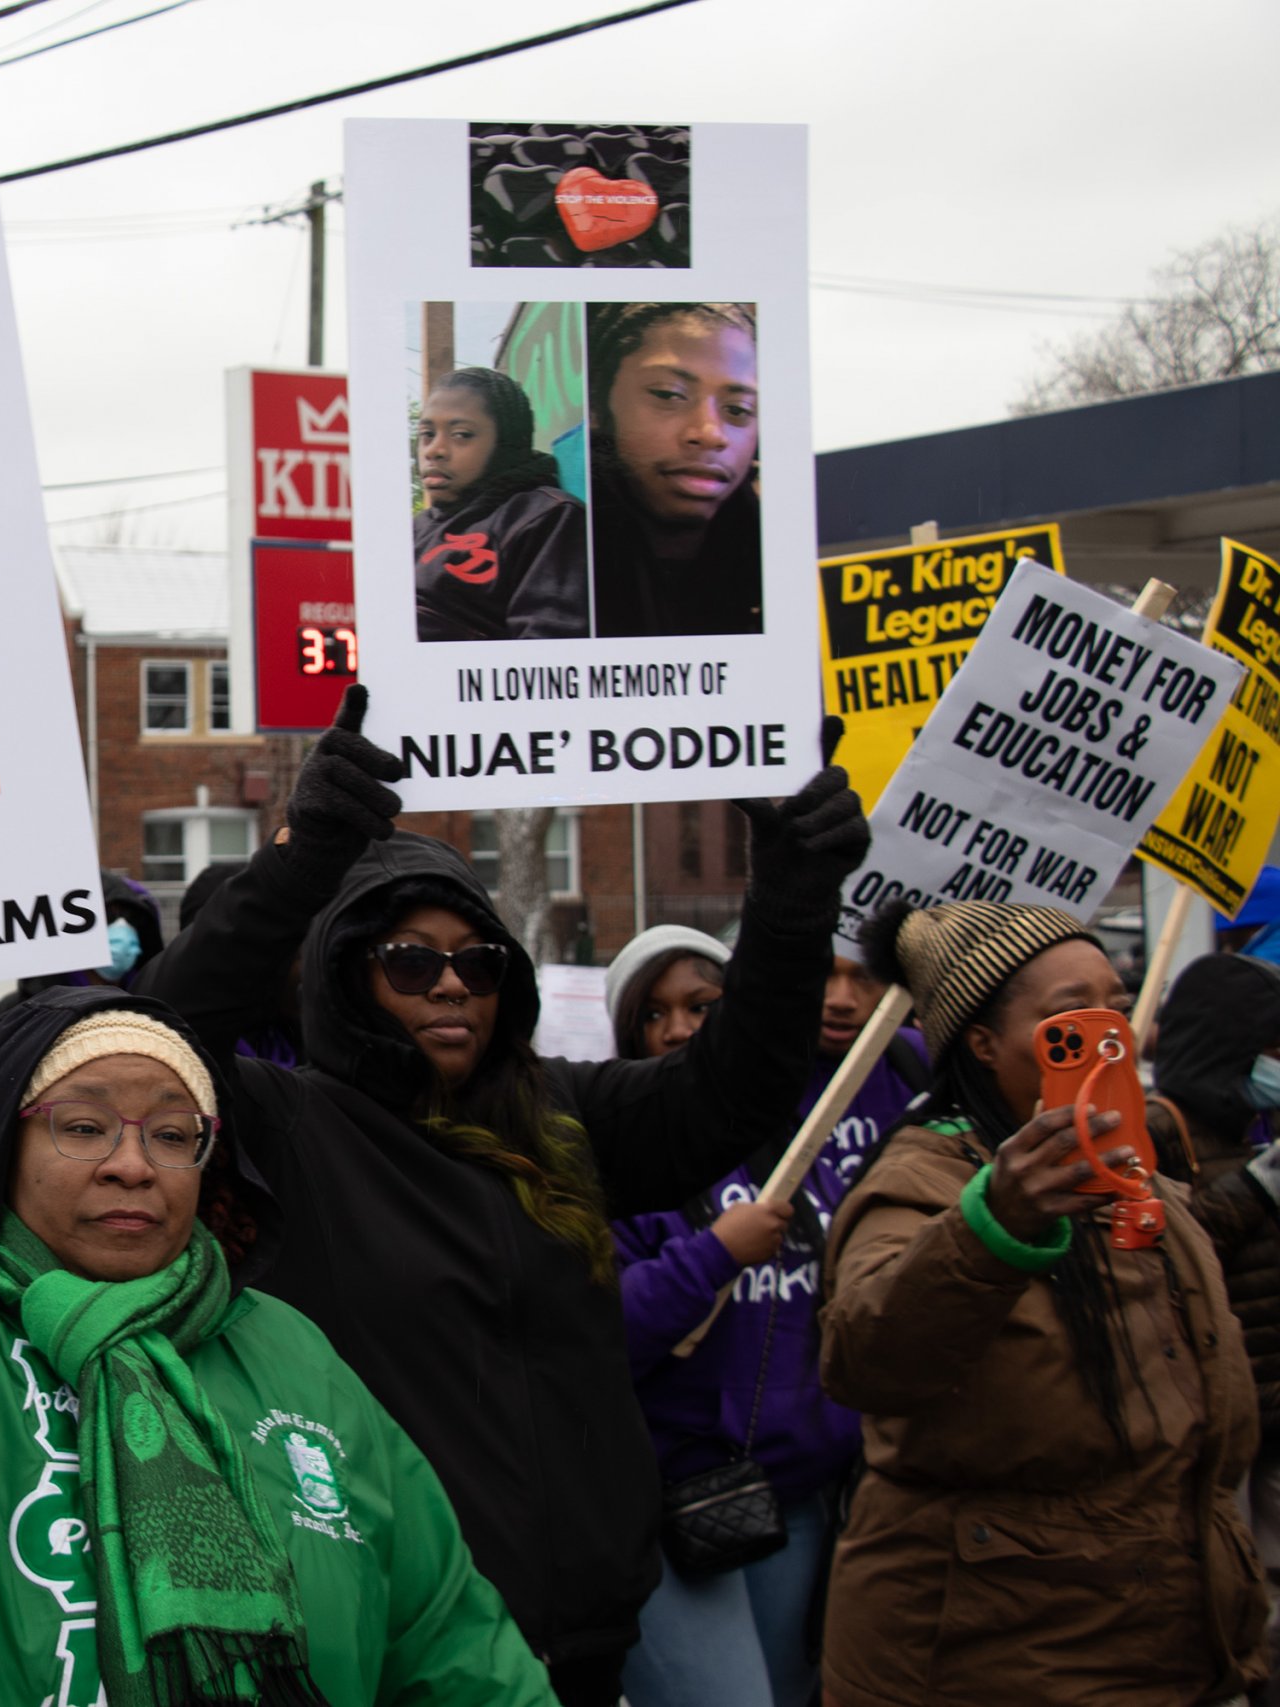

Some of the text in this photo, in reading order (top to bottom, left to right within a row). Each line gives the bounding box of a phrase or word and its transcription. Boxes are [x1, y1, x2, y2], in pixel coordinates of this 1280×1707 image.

[841, 563, 902, 604] Dr.
[1238, 556, 1274, 608] Dr.
[866, 594, 997, 647] Legac
[457, 661, 730, 702] IN LOVING MEMORY OF
[1011, 593, 1153, 693] MONEY
[1141, 656, 1217, 725] FOR
[1018, 668, 1152, 762] JOBS &
[589, 723, 788, 773] BODDIE
[952, 701, 1157, 823] EDUCATION
[1209, 727, 1261, 803] NOT
[897, 790, 972, 847] NOT
[961, 819, 1030, 876] FOR
[1024, 845, 1099, 905] WAR
[1180, 780, 1247, 869] WAR!
[939, 861, 1013, 905] AND
